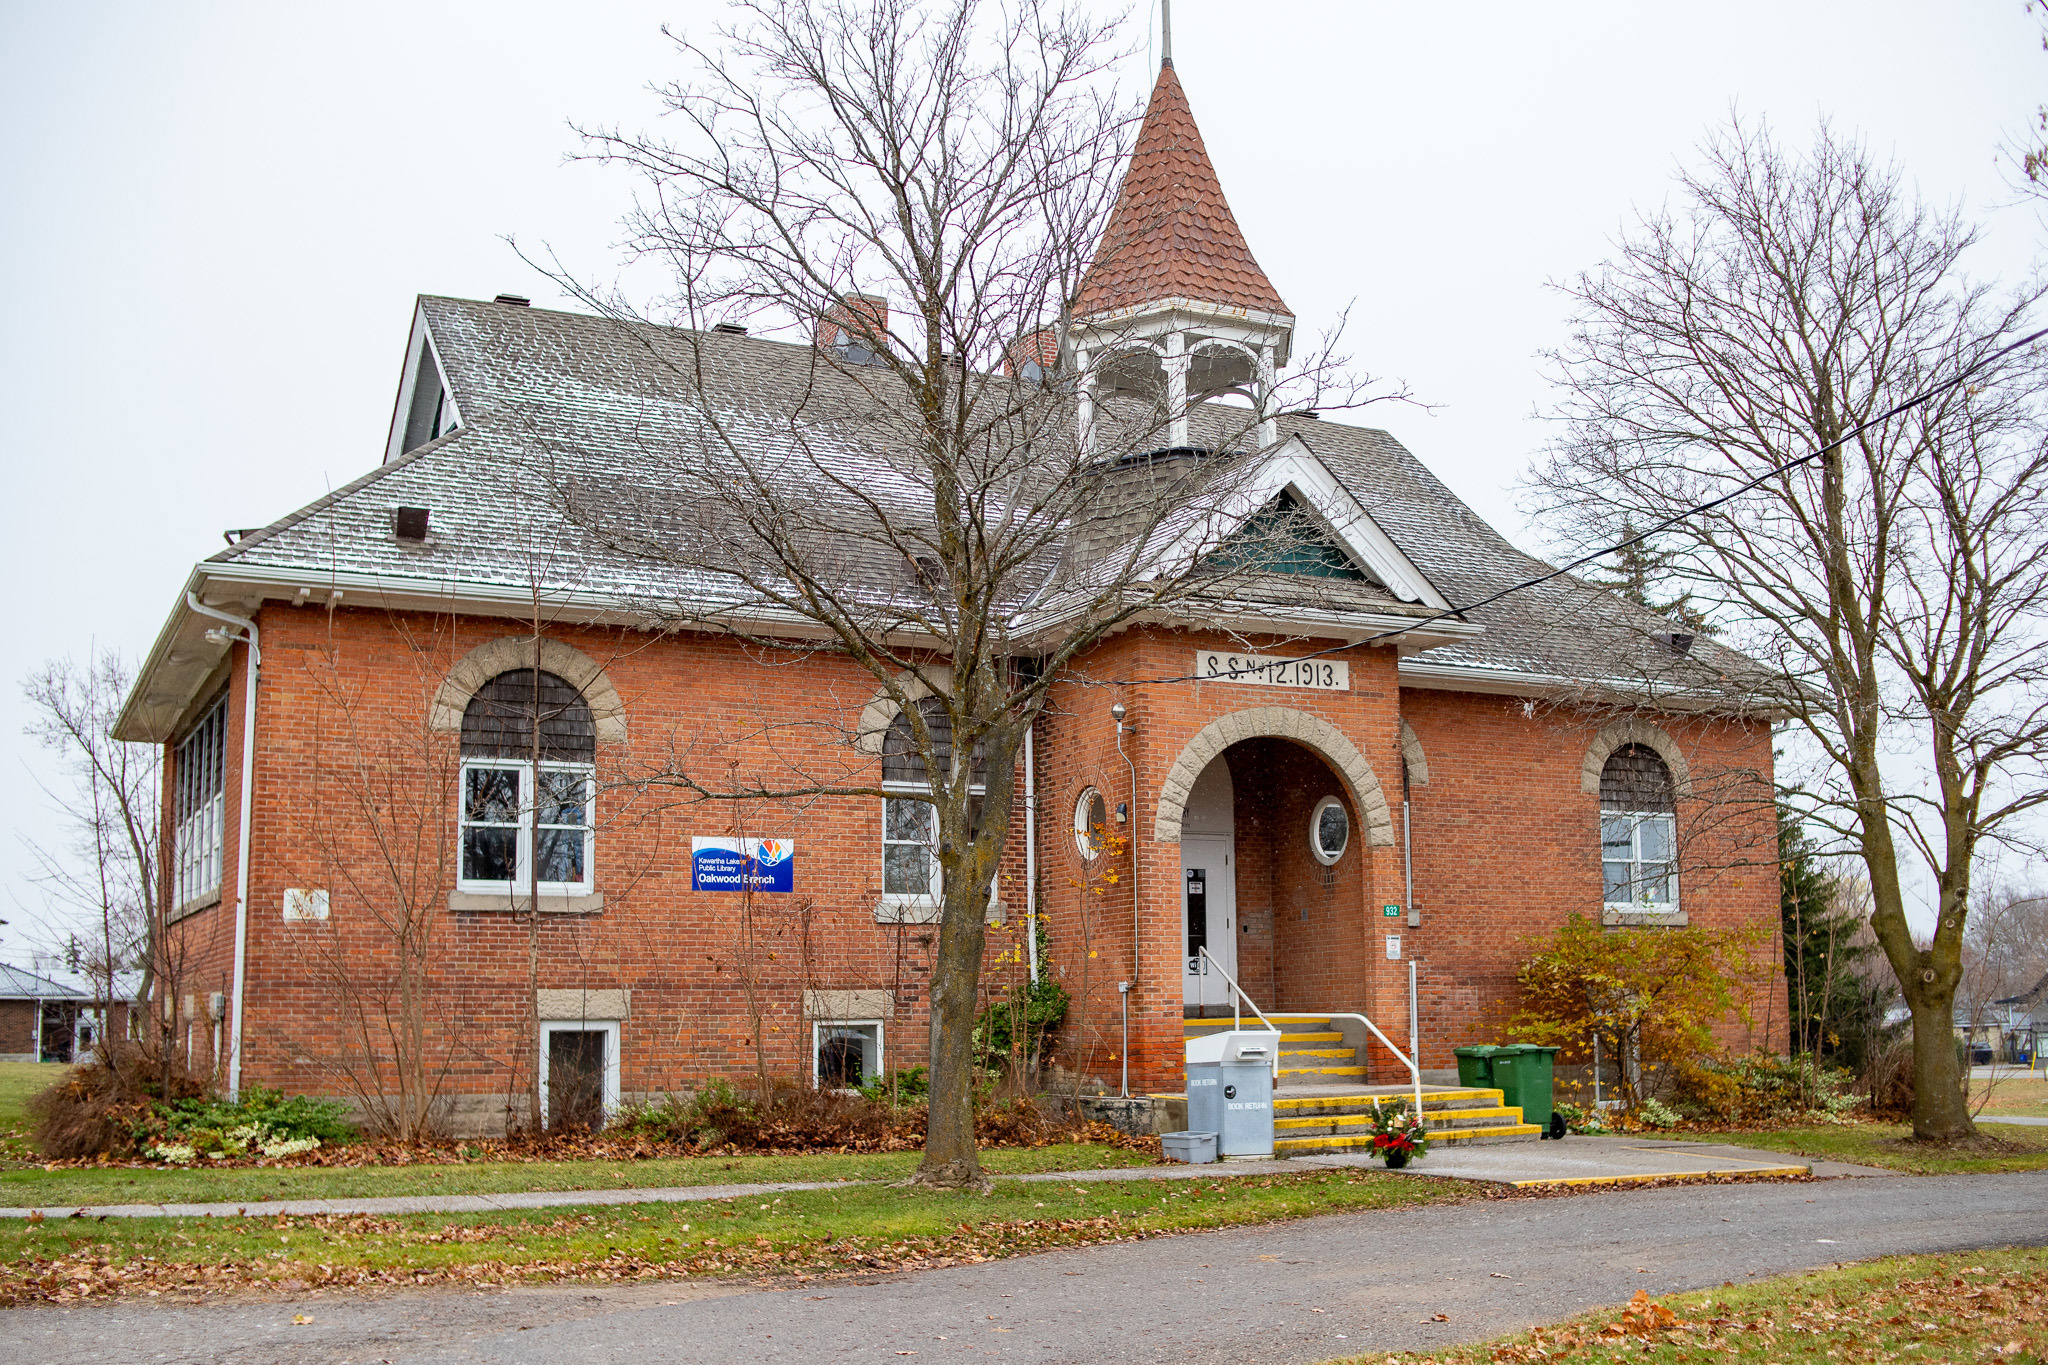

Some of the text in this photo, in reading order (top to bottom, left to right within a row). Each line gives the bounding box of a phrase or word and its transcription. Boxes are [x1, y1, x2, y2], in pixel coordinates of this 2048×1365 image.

[698, 857, 725, 865] Kawartha
[717, 865, 736, 873] Library
[698, 873, 740, 883] Oakwood
[1386, 906, 1397, 916] 932
[1190, 1078, 1217, 1087] BOOK RETURN
[1227, 1102, 1267, 1110] BOOK RETURN
